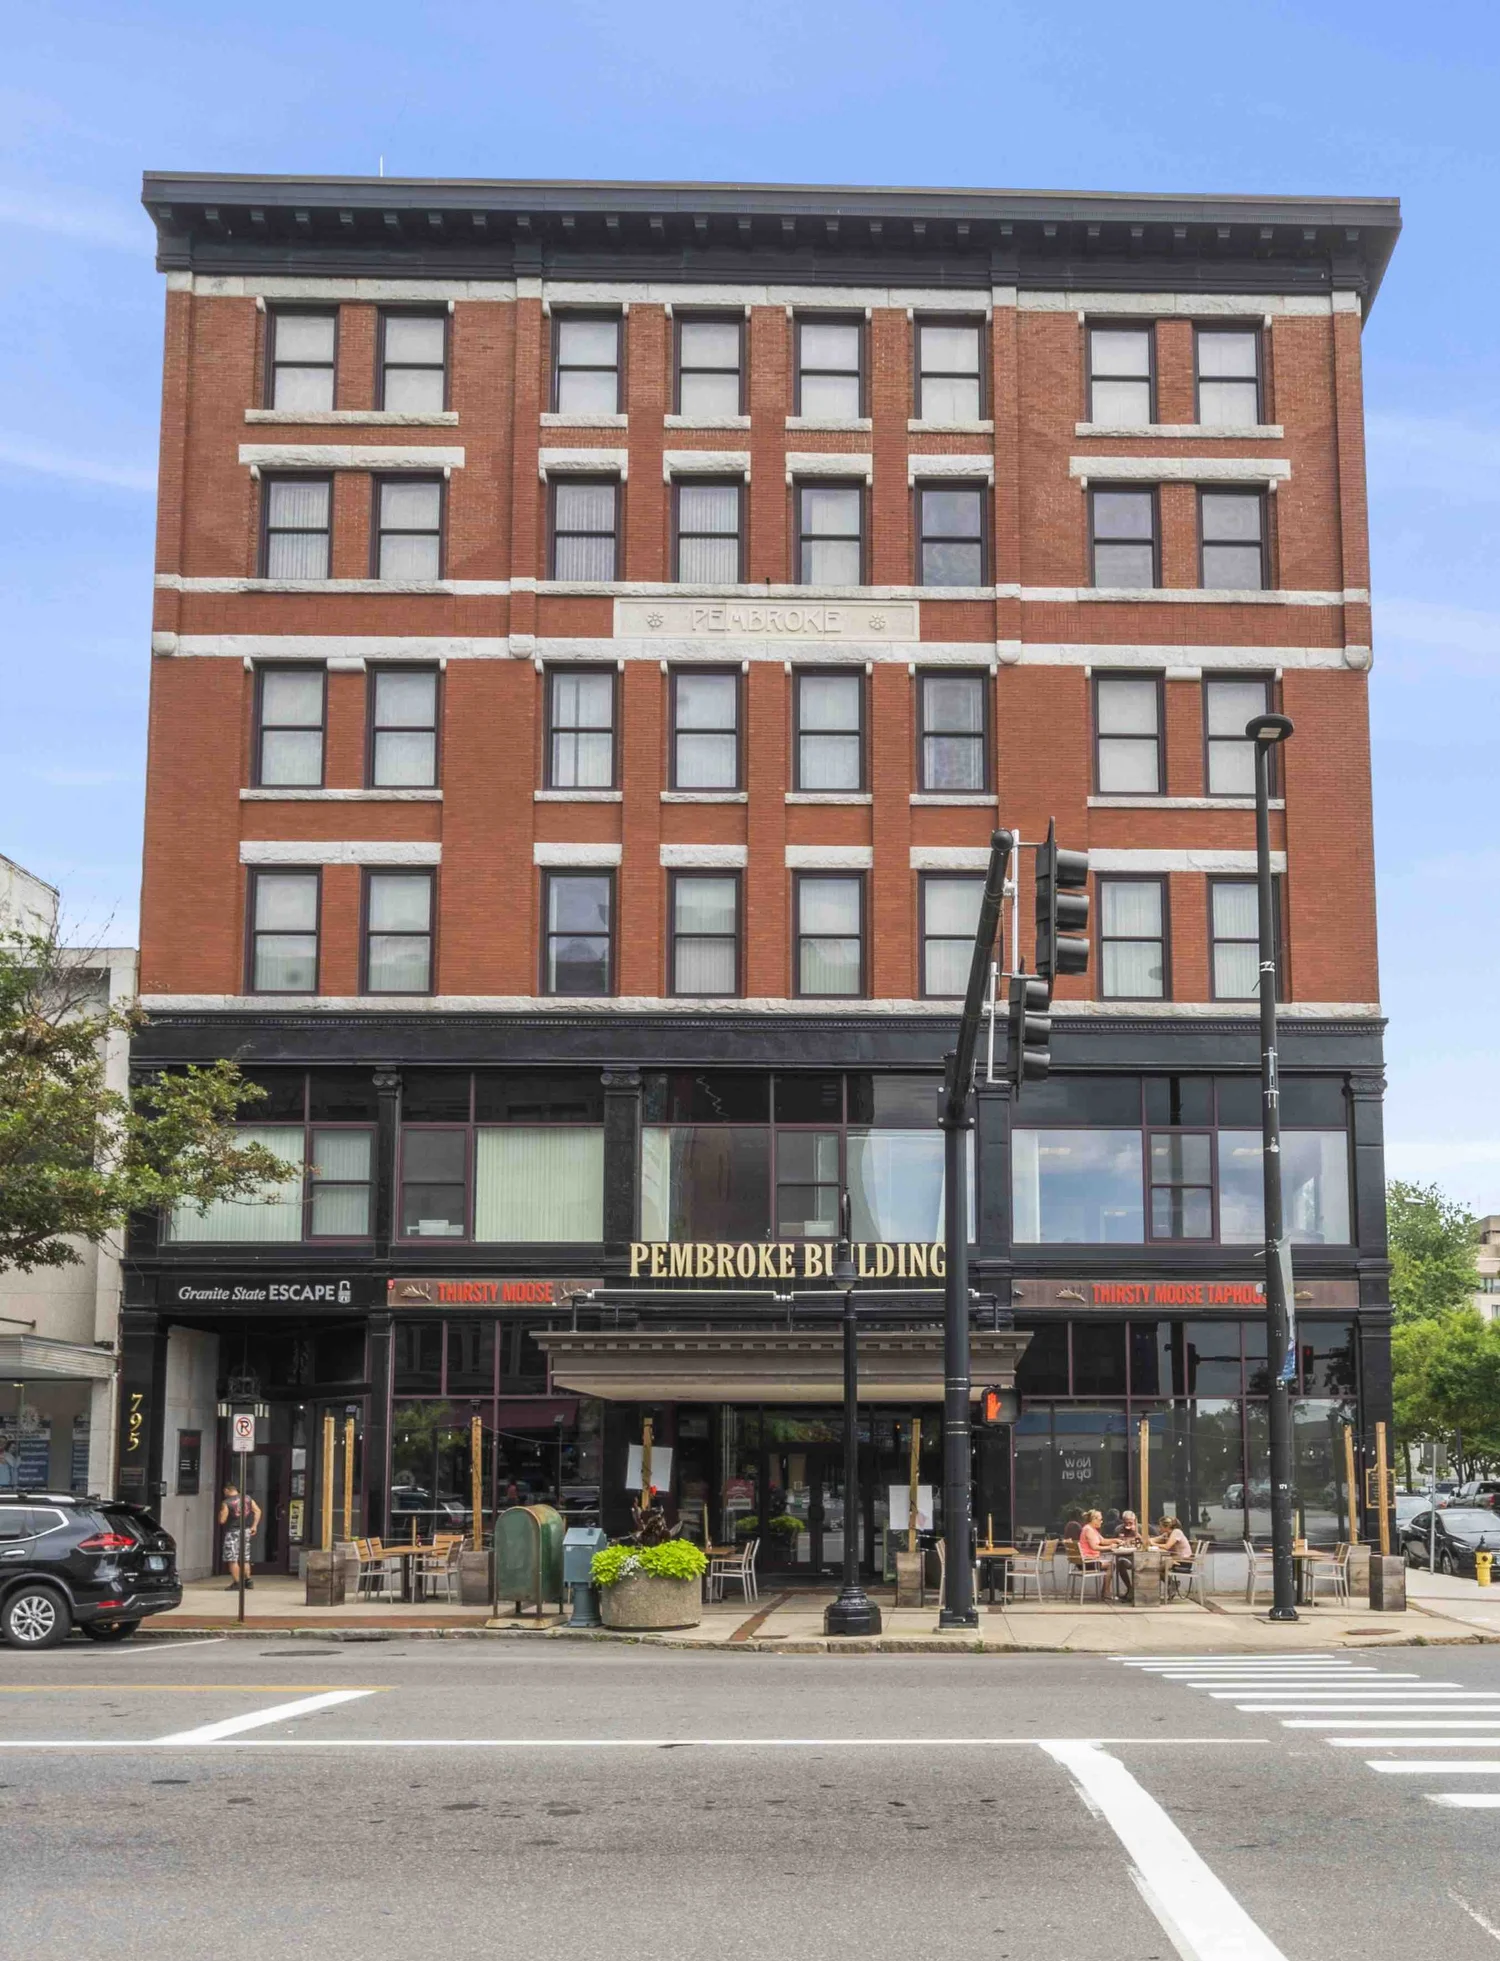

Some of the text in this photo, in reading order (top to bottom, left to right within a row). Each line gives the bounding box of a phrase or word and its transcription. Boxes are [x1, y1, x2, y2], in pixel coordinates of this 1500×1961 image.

[691, 607, 842, 633] PEMBROKE
[629, 1242, 796, 1278] PEMBROKE
[178, 1285, 336, 1301] Granite State ESCAPE
[437, 1282, 554, 1302] THIRSTY MOOSE
[1092, 1283, 1152, 1305] THIRSTY
[1153, 1284, 1203, 1305] MOOSE
[127, 1393, 143, 1452] 795
